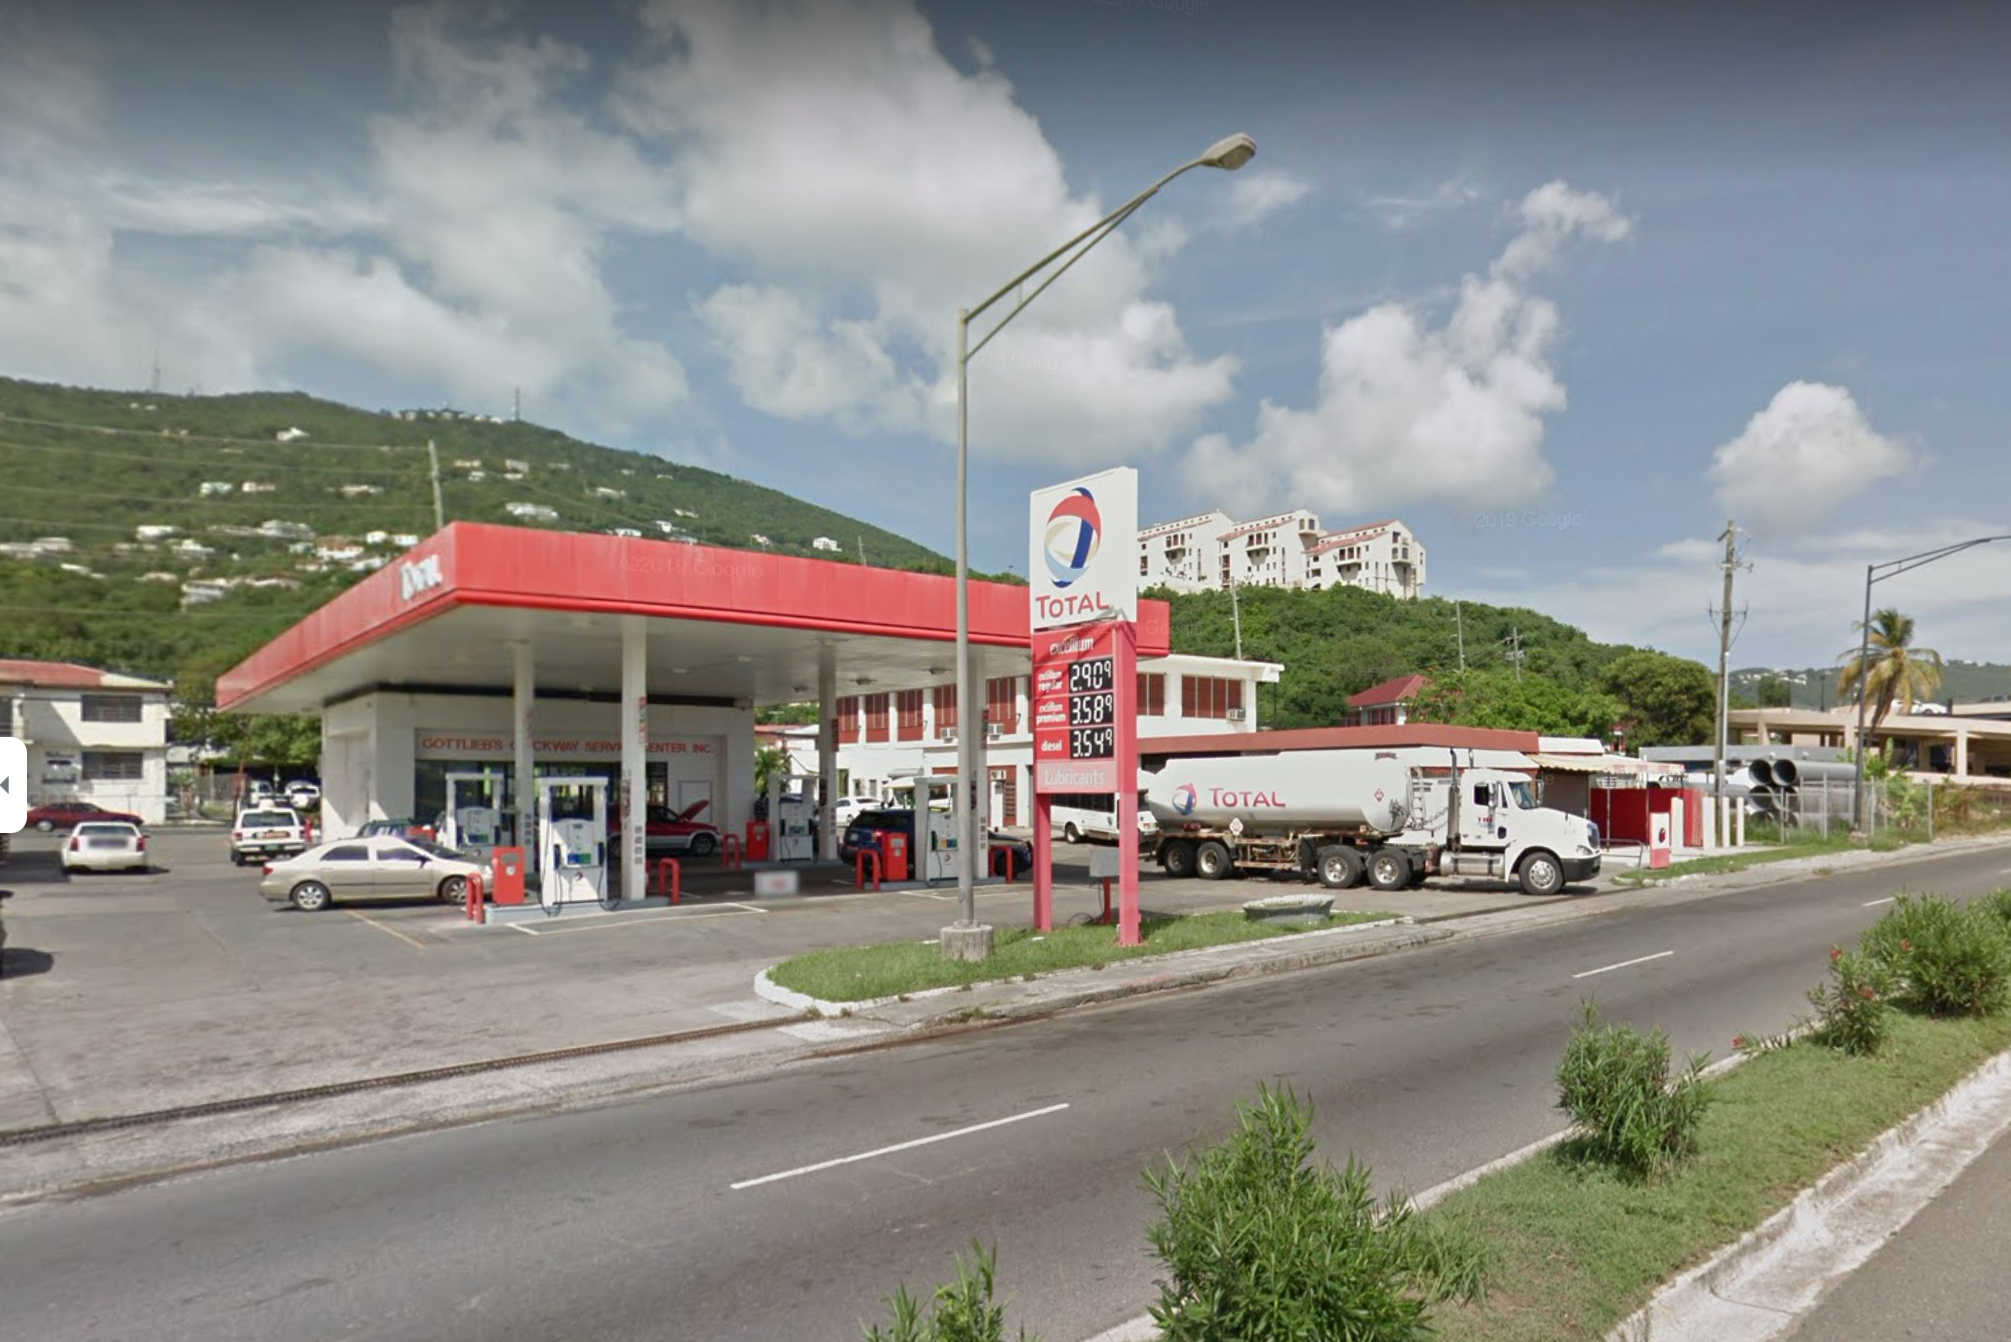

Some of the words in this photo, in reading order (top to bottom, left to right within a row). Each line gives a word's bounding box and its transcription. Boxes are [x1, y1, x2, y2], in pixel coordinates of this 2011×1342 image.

[1036, 591, 1110, 619] TOTAL
[646, 742, 687, 754] ENTER
[1041, 739, 1063, 752] diesel
[1208, 787, 1287, 808] TOTAL
